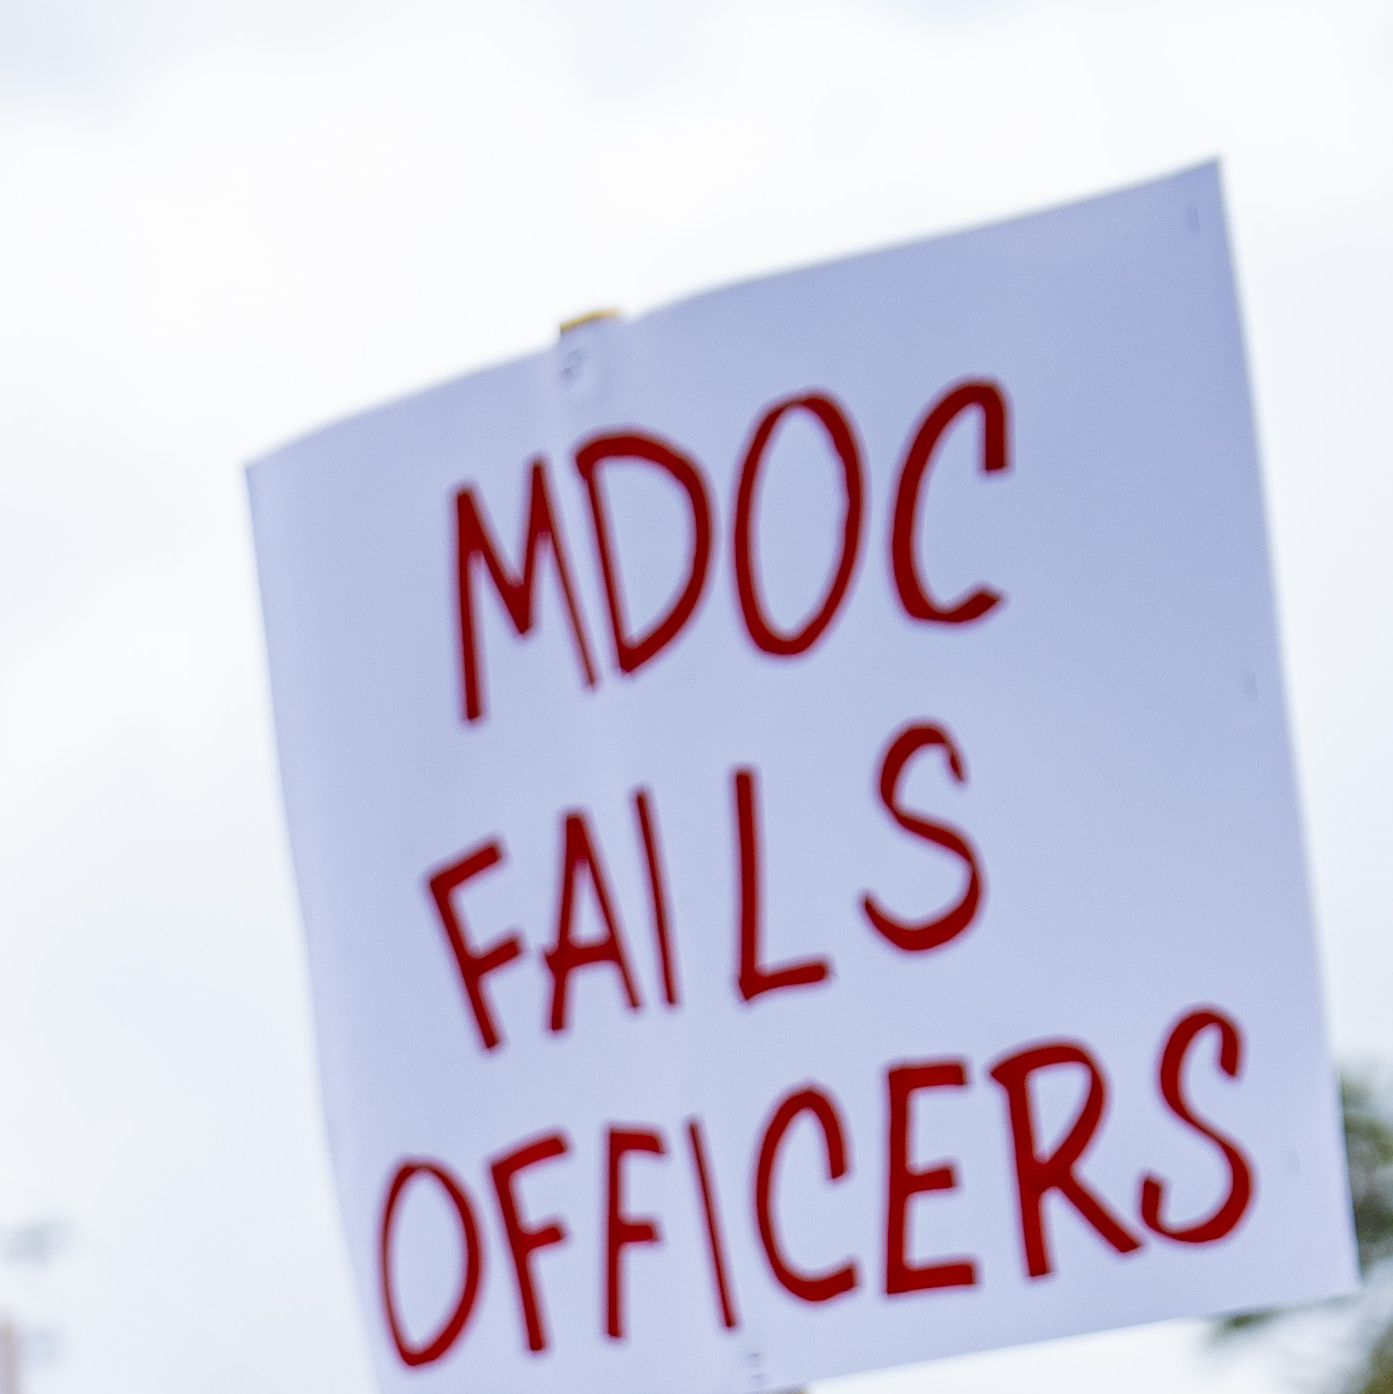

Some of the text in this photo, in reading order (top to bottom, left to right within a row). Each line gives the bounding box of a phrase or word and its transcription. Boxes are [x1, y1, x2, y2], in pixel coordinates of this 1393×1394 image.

[453, 378, 1011, 722] MDOC
[427, 720, 985, 1051] FAILS
[379, 1007, 1254, 1368] OFFICERS
